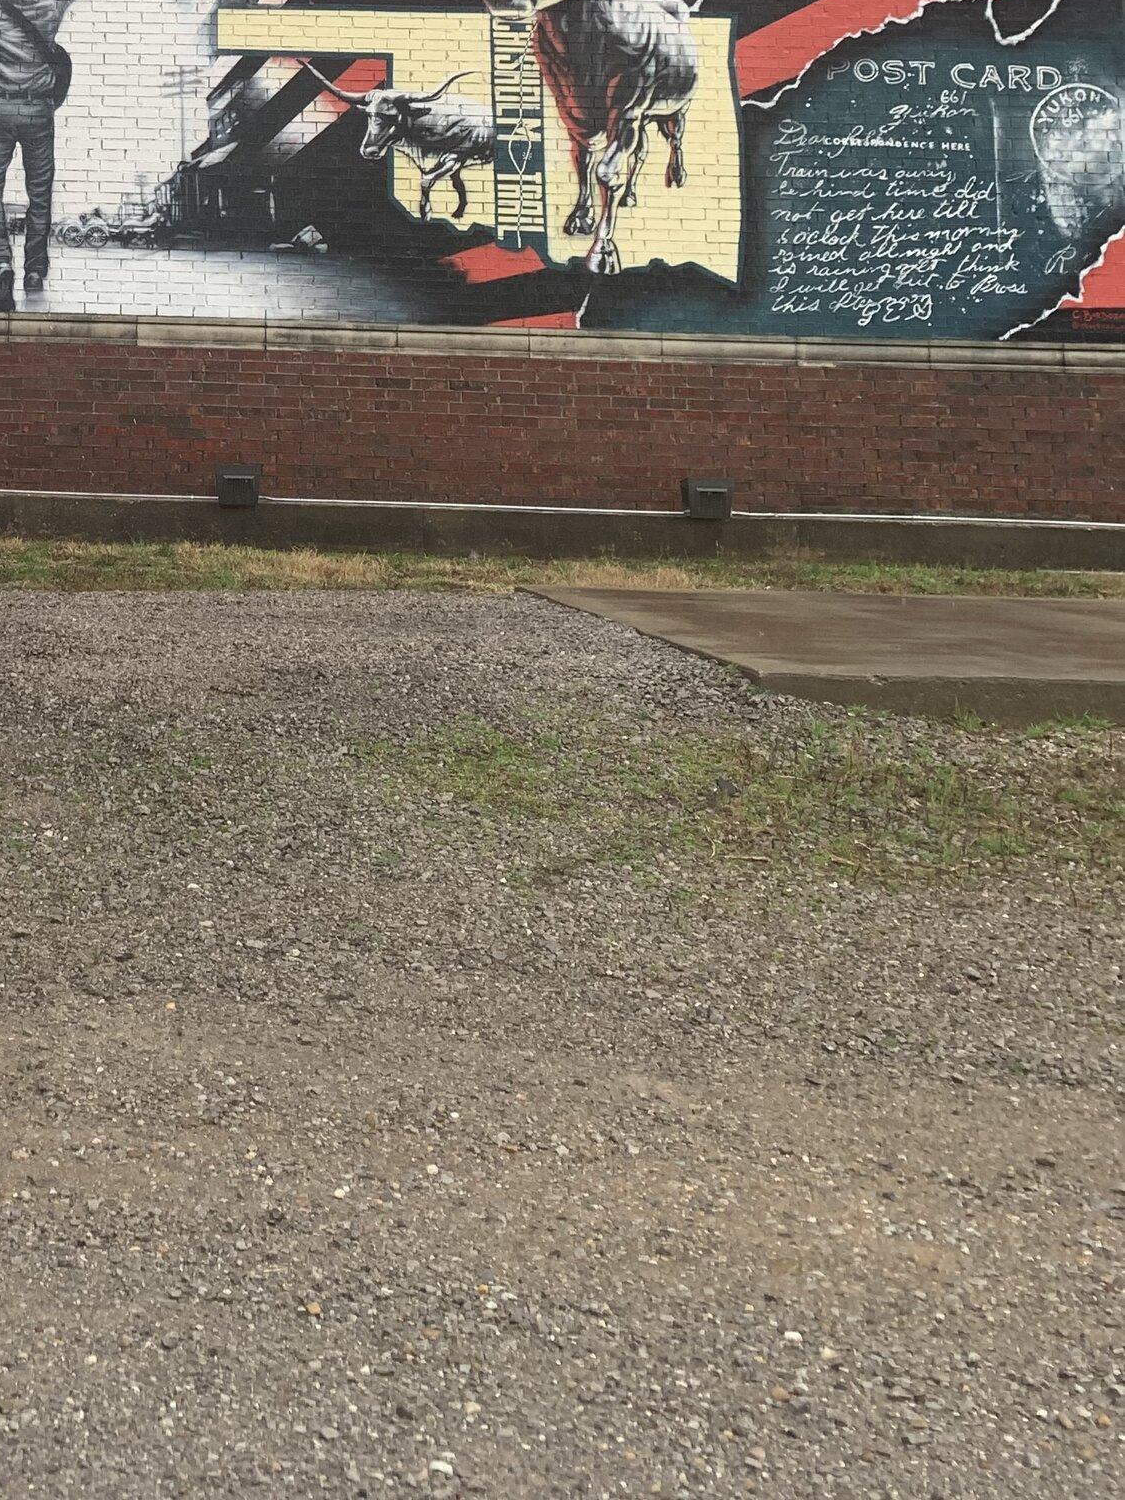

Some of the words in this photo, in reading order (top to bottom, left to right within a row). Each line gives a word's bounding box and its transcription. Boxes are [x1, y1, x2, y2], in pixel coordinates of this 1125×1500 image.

[492, 16, 542, 142] CHISHOLM
[827, 58, 936, 86] POST
[949, 62, 1063, 92] CARD
[1037, 89, 1101, 124] YUKON
[940, 141, 972, 152] HERE
[496, 171, 545, 241] TRAIL
